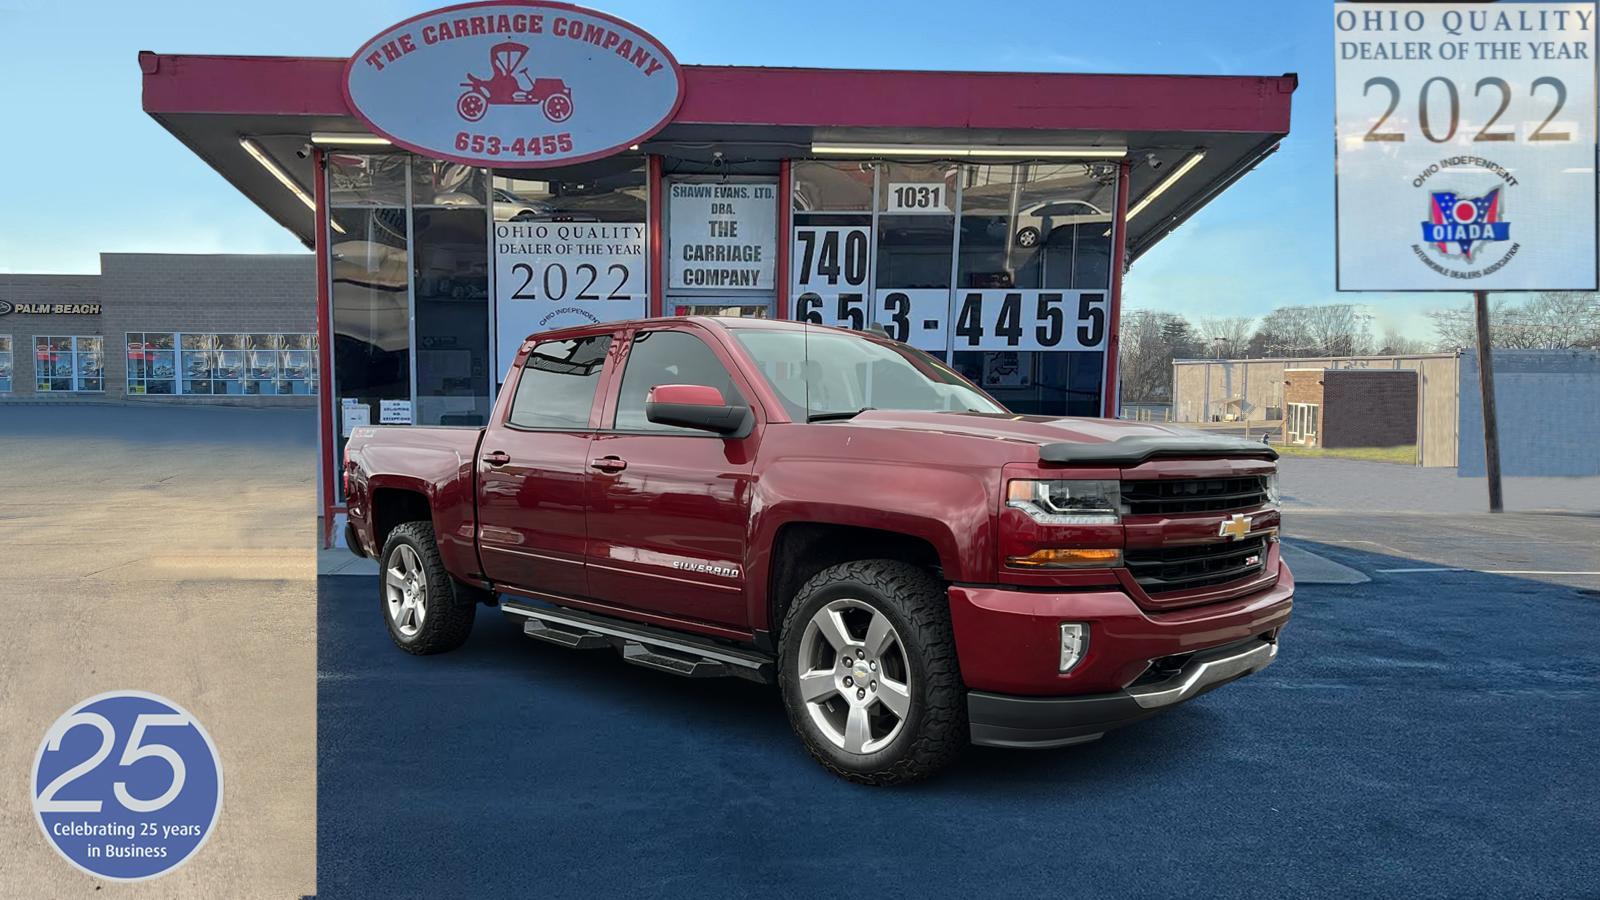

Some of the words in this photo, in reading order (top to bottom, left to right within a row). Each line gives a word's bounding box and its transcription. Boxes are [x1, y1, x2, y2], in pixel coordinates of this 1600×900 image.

[1336, 10, 1425, 31] OHIO
[1442, 10, 1593, 35] QUALITY
[365, 33, 416, 72] THE
[422, 14, 544, 45] CARRIAGE
[552, 16, 664, 77] COMPANY
[1340, 41, 1433, 60] DEALER
[1438, 41, 1469, 60] OF
[1475, 41, 1521, 60] THE
[1528, 41, 1589, 60] YEAR
[1362, 76, 1571, 143] 2022
[455, 131, 573, 156] 653-4455
[1412, 163, 1440, 188] OHIO
[1440, 155, 1519, 187] INDEPENDENT
[672, 186, 712, 199] SHAWN
[895, 187, 940, 208] 1031
[711, 203, 736, 215] DBA.
[497, 226, 548, 239] OHIO
[557, 226, 644, 241] QUALITY
[708, 220, 738, 238] THE
[1432, 224, 1495, 240] OIADA
[499, 243, 552, 255] DEALER
[555, 243, 573, 255] OF
[576, 243, 603, 255] THE
[606, 243, 642, 255] YEAR
[683, 244, 762, 262] CARRIAGE
[797, 230, 868, 286] 740
[510, 262, 632, 301] 2022
[683, 268, 760, 286] COMPANY
[14, 303, 50, 314] PALM
[54, 303, 100, 314] BEACH
[539, 312, 555, 326] OHIO
